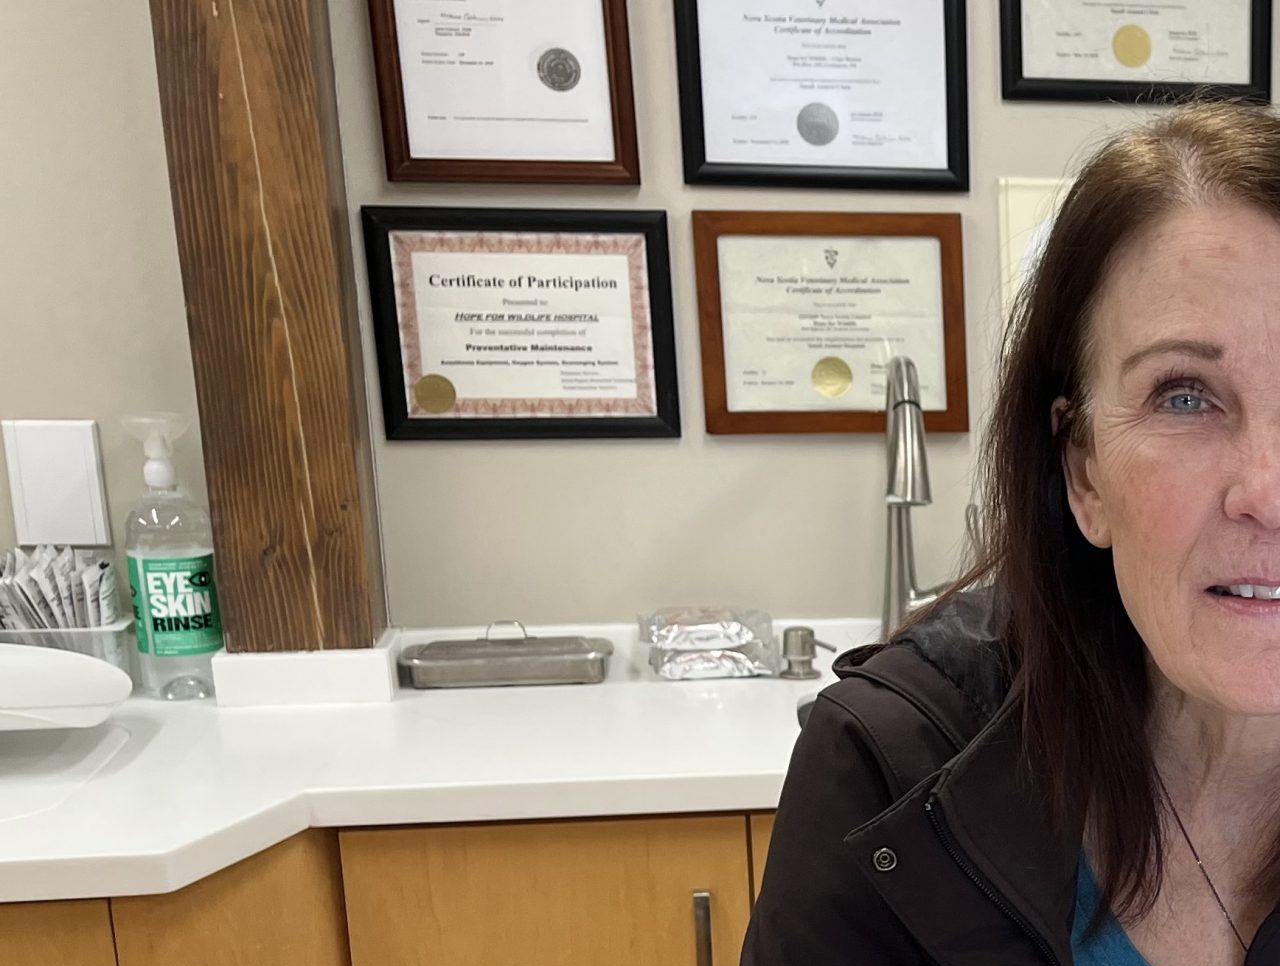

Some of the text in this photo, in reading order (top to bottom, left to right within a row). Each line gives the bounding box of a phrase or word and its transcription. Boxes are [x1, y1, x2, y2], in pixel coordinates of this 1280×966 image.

[428, 274, 618, 291] Certificate of Participation
[502, 298, 537, 306] Presented
[454, 312, 600, 322] HOPE FOR WILDLIFE HOSPITAL
[485, 328, 496, 336] the
[465, 343, 593, 352] Preventative Maintenance
[146, 571, 193, 594] EYE
[150, 591, 211, 618] SKIN
[153, 613, 213, 631] RINSE
